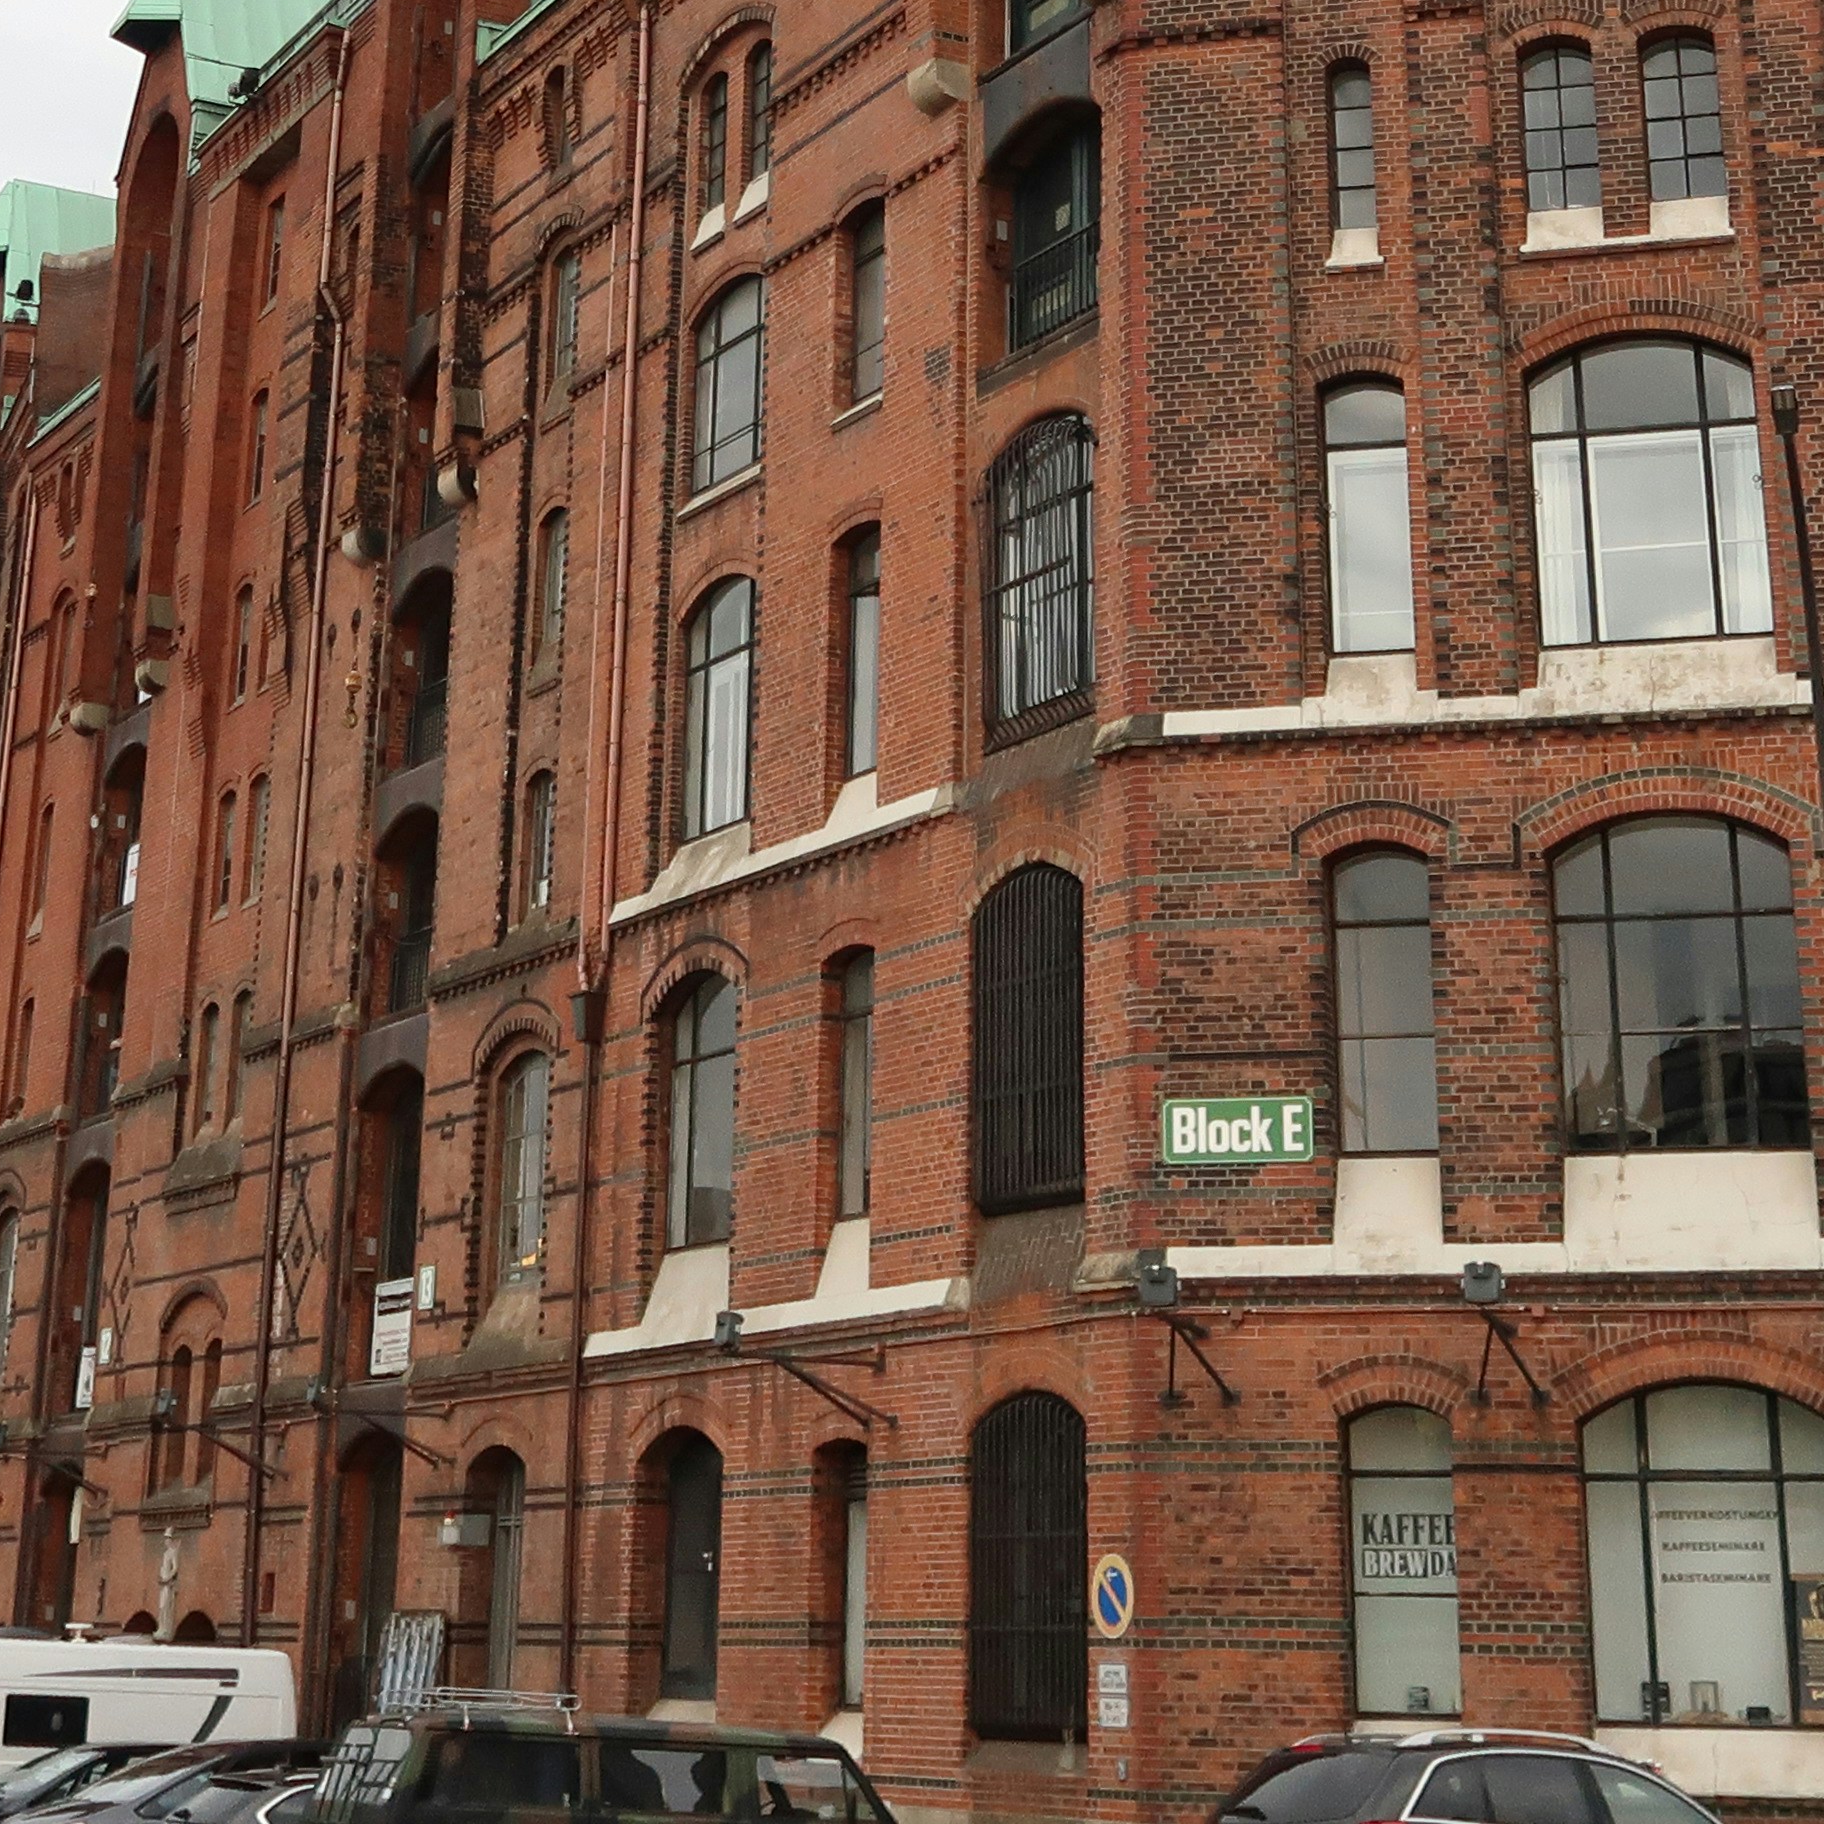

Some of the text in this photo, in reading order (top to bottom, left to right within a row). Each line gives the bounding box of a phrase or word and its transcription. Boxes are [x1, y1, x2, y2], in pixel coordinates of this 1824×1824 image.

[1172, 1104, 1305, 1154] Block E
[1362, 1514, 1455, 1545] KAFFEE
